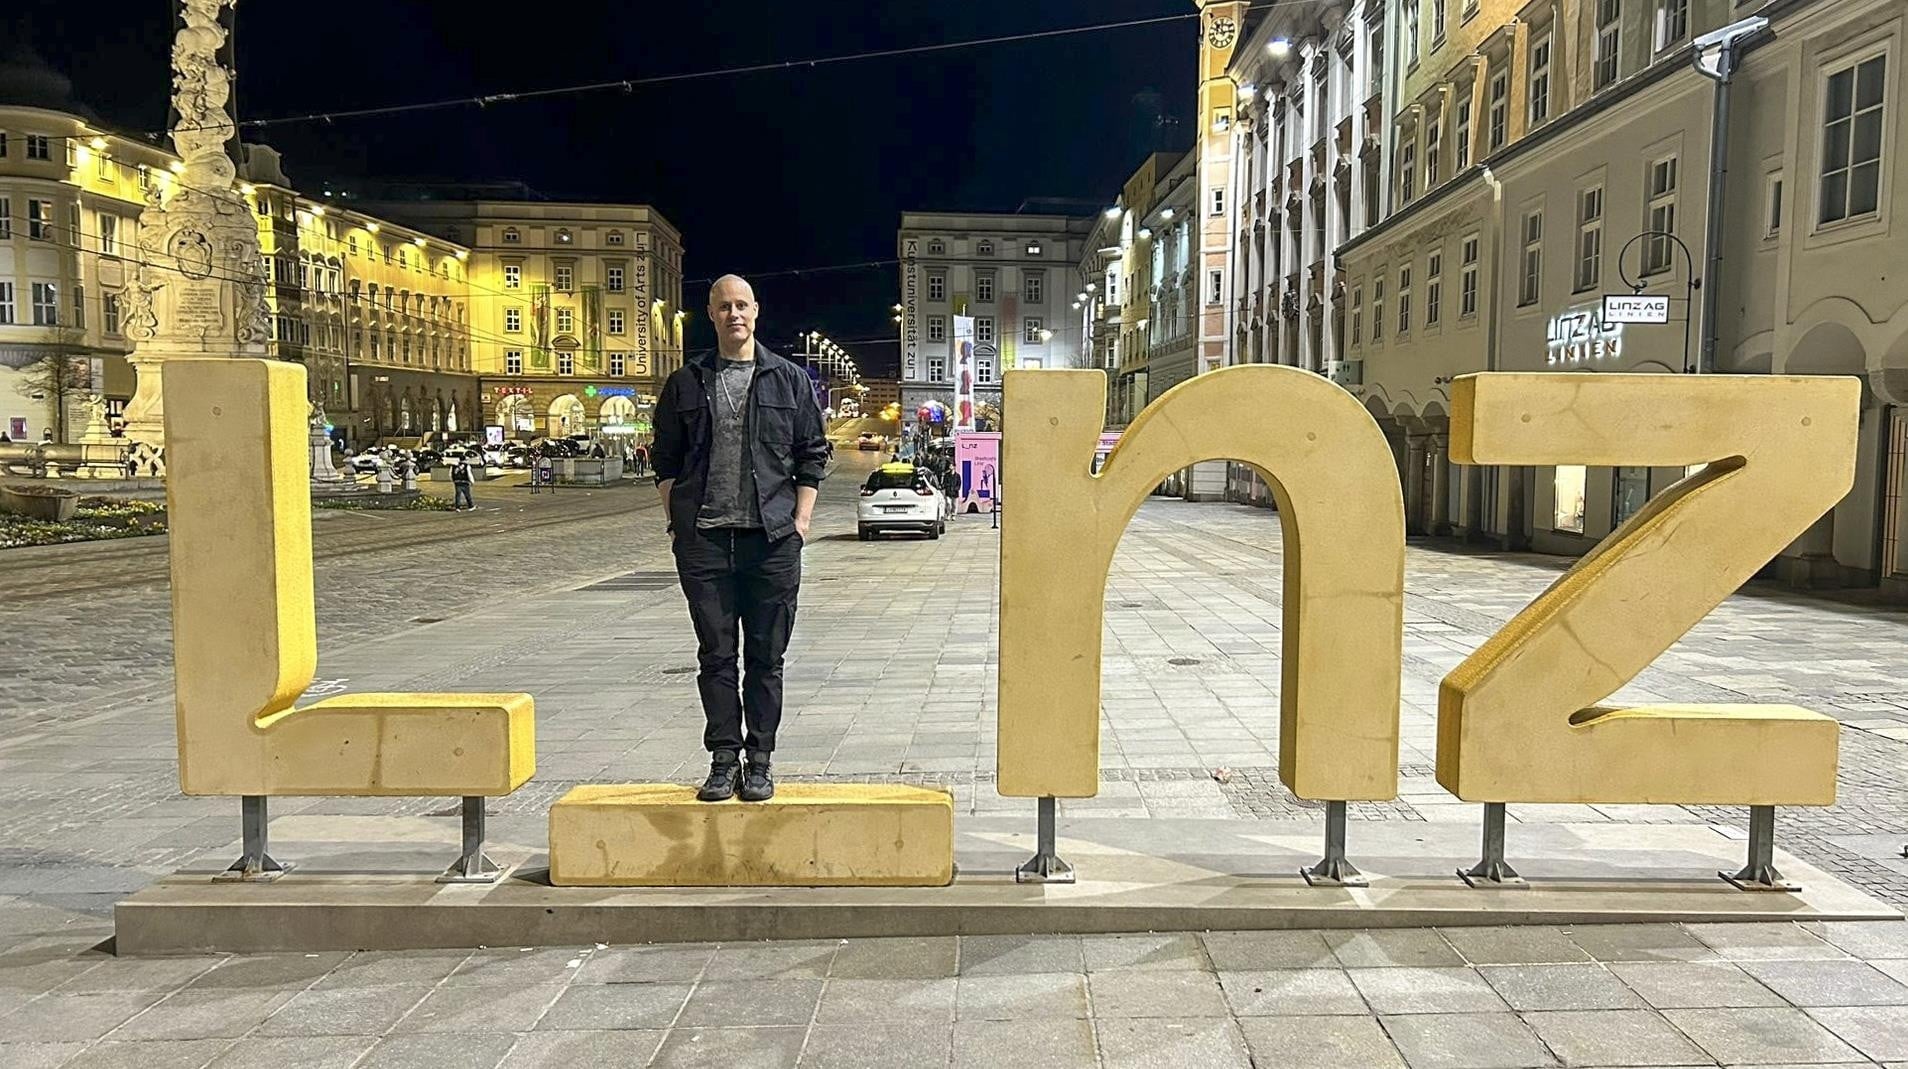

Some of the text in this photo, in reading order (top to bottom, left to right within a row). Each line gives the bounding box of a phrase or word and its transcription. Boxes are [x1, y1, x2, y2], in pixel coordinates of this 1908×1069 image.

[635, 265, 646, 294] Arts
[635, 295, 646, 308] of
[906, 240, 918, 348] Kunstuniversität
[1643, 302, 1665, 311] AG
[635, 310, 649, 375] University
[1545, 339, 1619, 362] LINIEN
